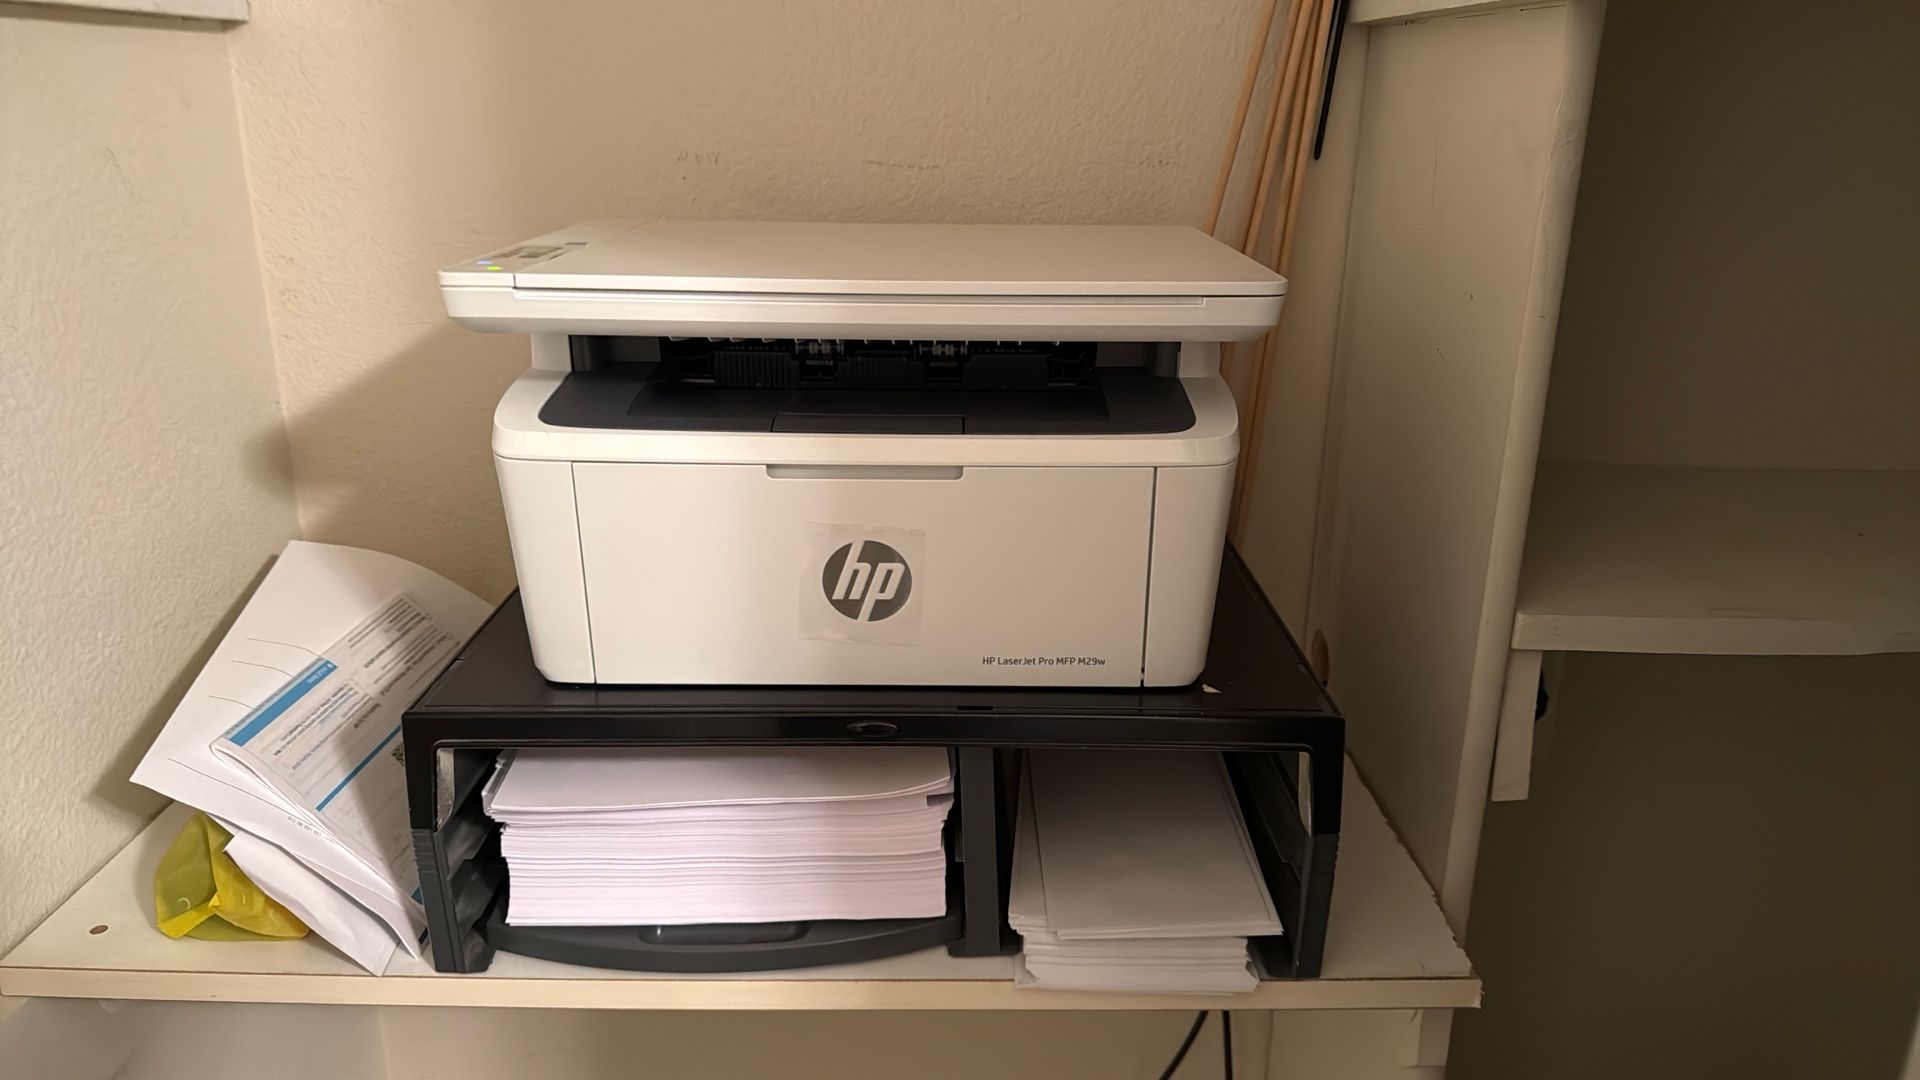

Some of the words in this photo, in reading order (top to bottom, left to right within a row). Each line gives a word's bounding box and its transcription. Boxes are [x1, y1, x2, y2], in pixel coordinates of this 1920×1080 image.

[831, 540, 906, 622] hp
[982, 656, 996, 666] HP
[997, 656, 1037, 666] LaserJet
[1038, 656, 1055, 666] Pro
[1056, 656, 1076, 666] MFP
[1077, 656, 1106, 666] M29w
